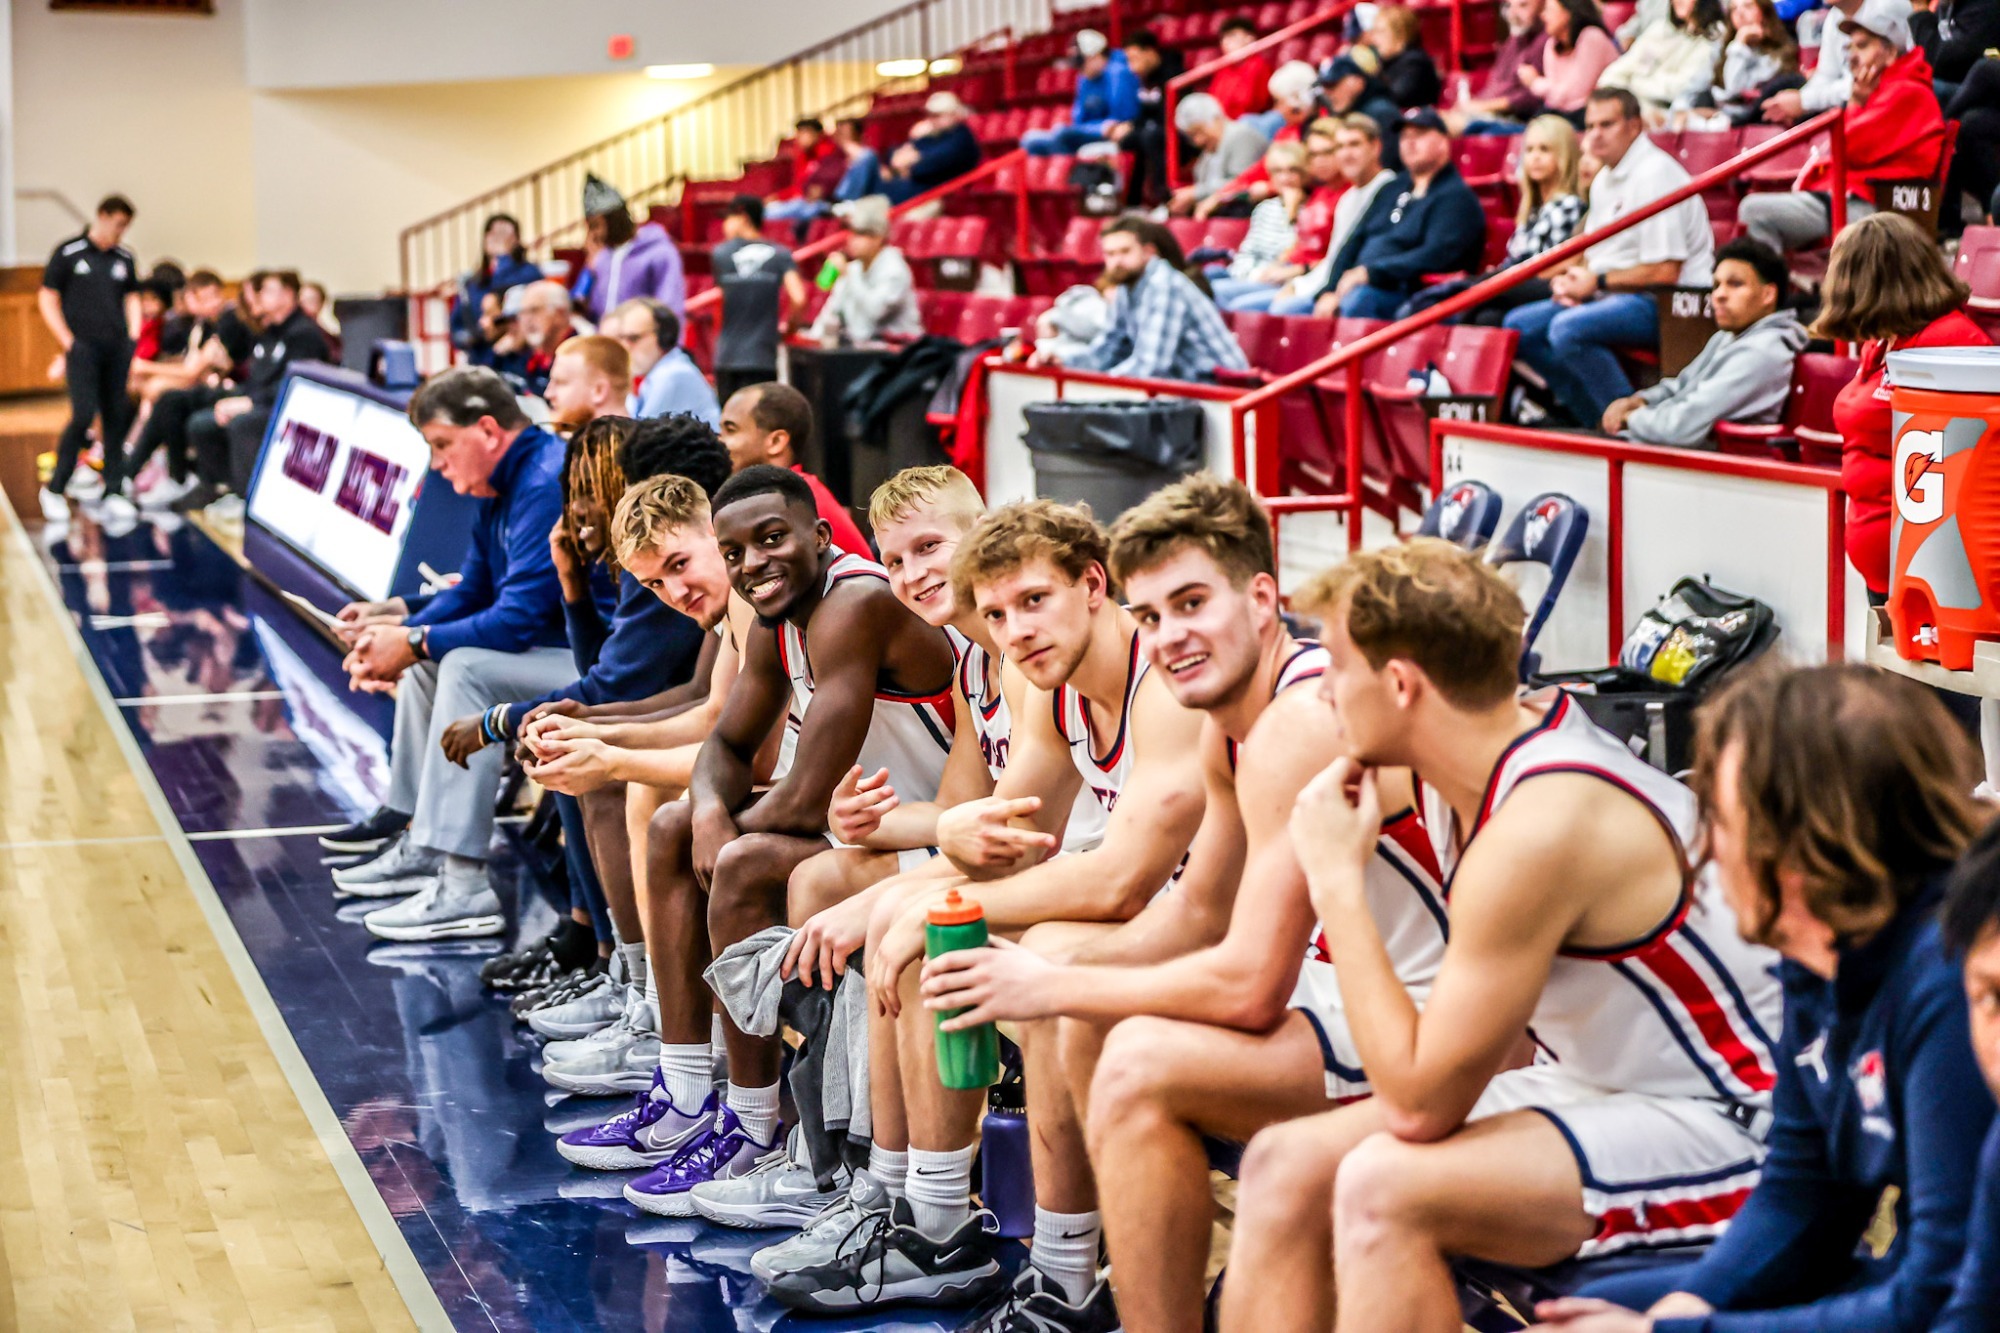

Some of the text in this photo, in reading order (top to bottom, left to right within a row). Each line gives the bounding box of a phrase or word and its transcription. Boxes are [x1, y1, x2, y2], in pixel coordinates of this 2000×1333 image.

[1892, 185, 1931, 212] ROW 3
[1672, 291, 1712, 318] ROW 2
[1894, 429, 1944, 524] G
